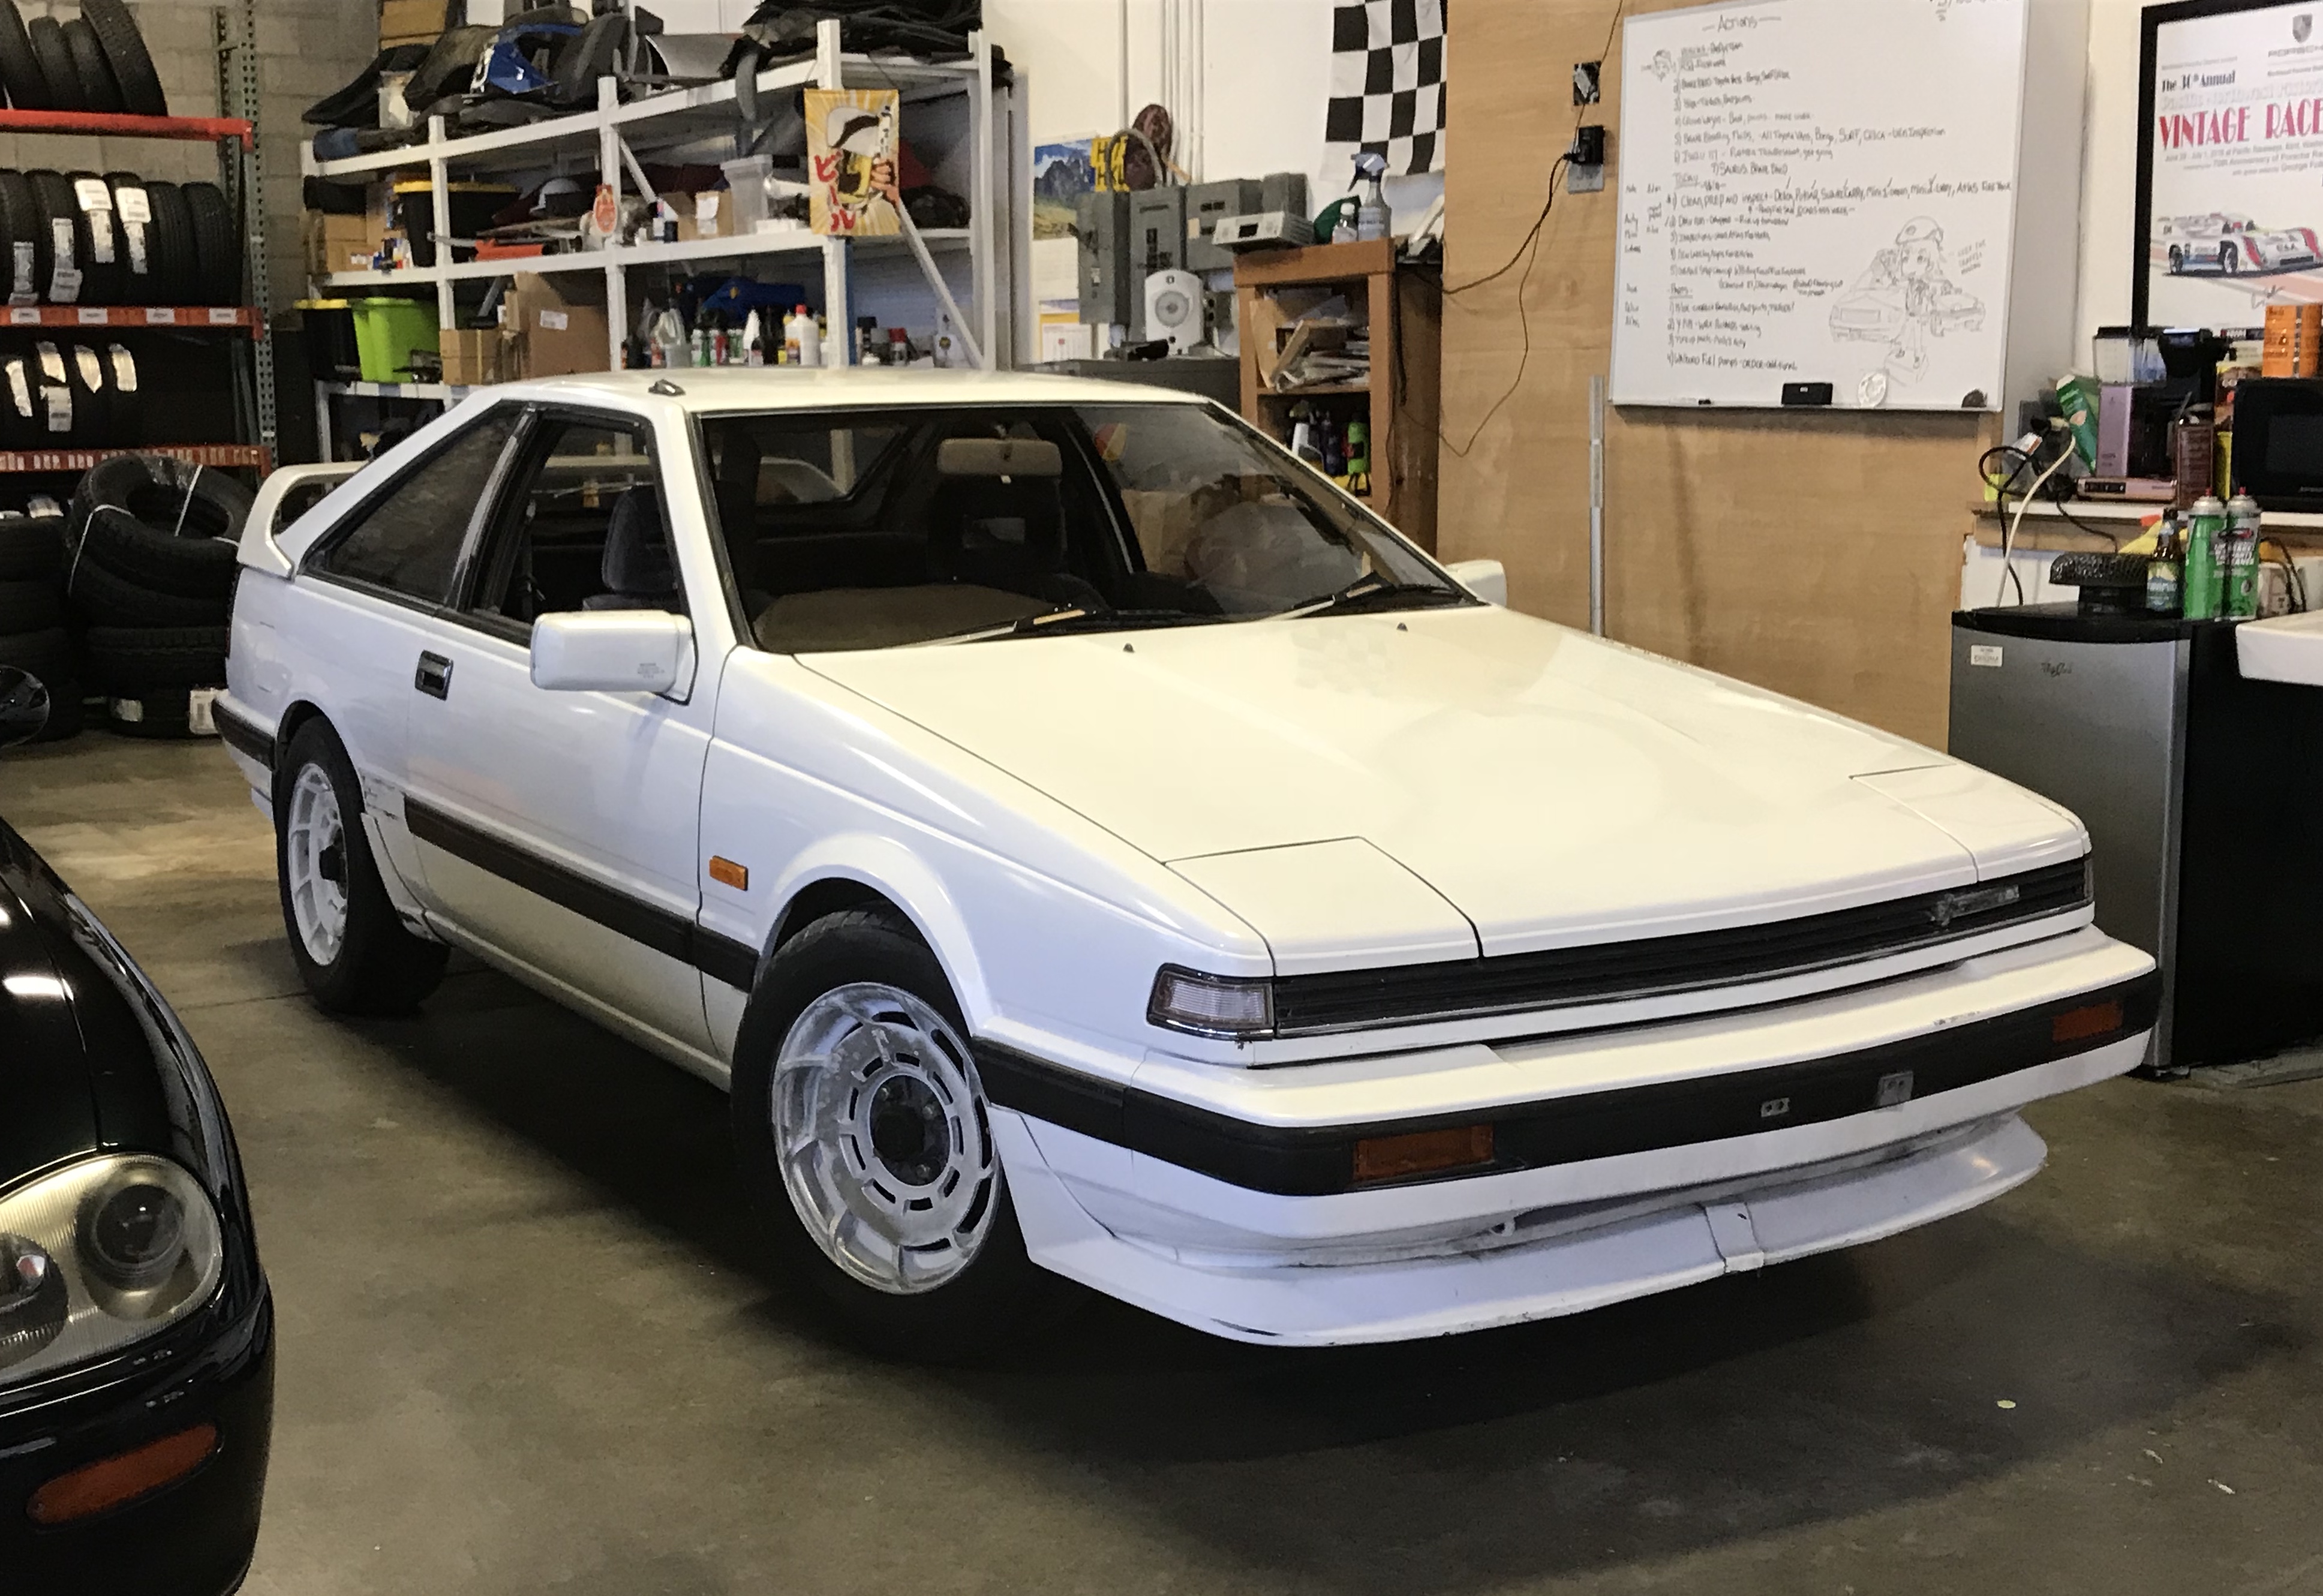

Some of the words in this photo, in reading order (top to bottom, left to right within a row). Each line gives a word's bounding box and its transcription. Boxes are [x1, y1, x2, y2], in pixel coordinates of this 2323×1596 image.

[2162, 79, 2177, 92] The
[2200, 69, 2237, 88] Annual
[2159, 106, 2251, 151] VINTAGE
[814, 148, 857, 232] ビール
